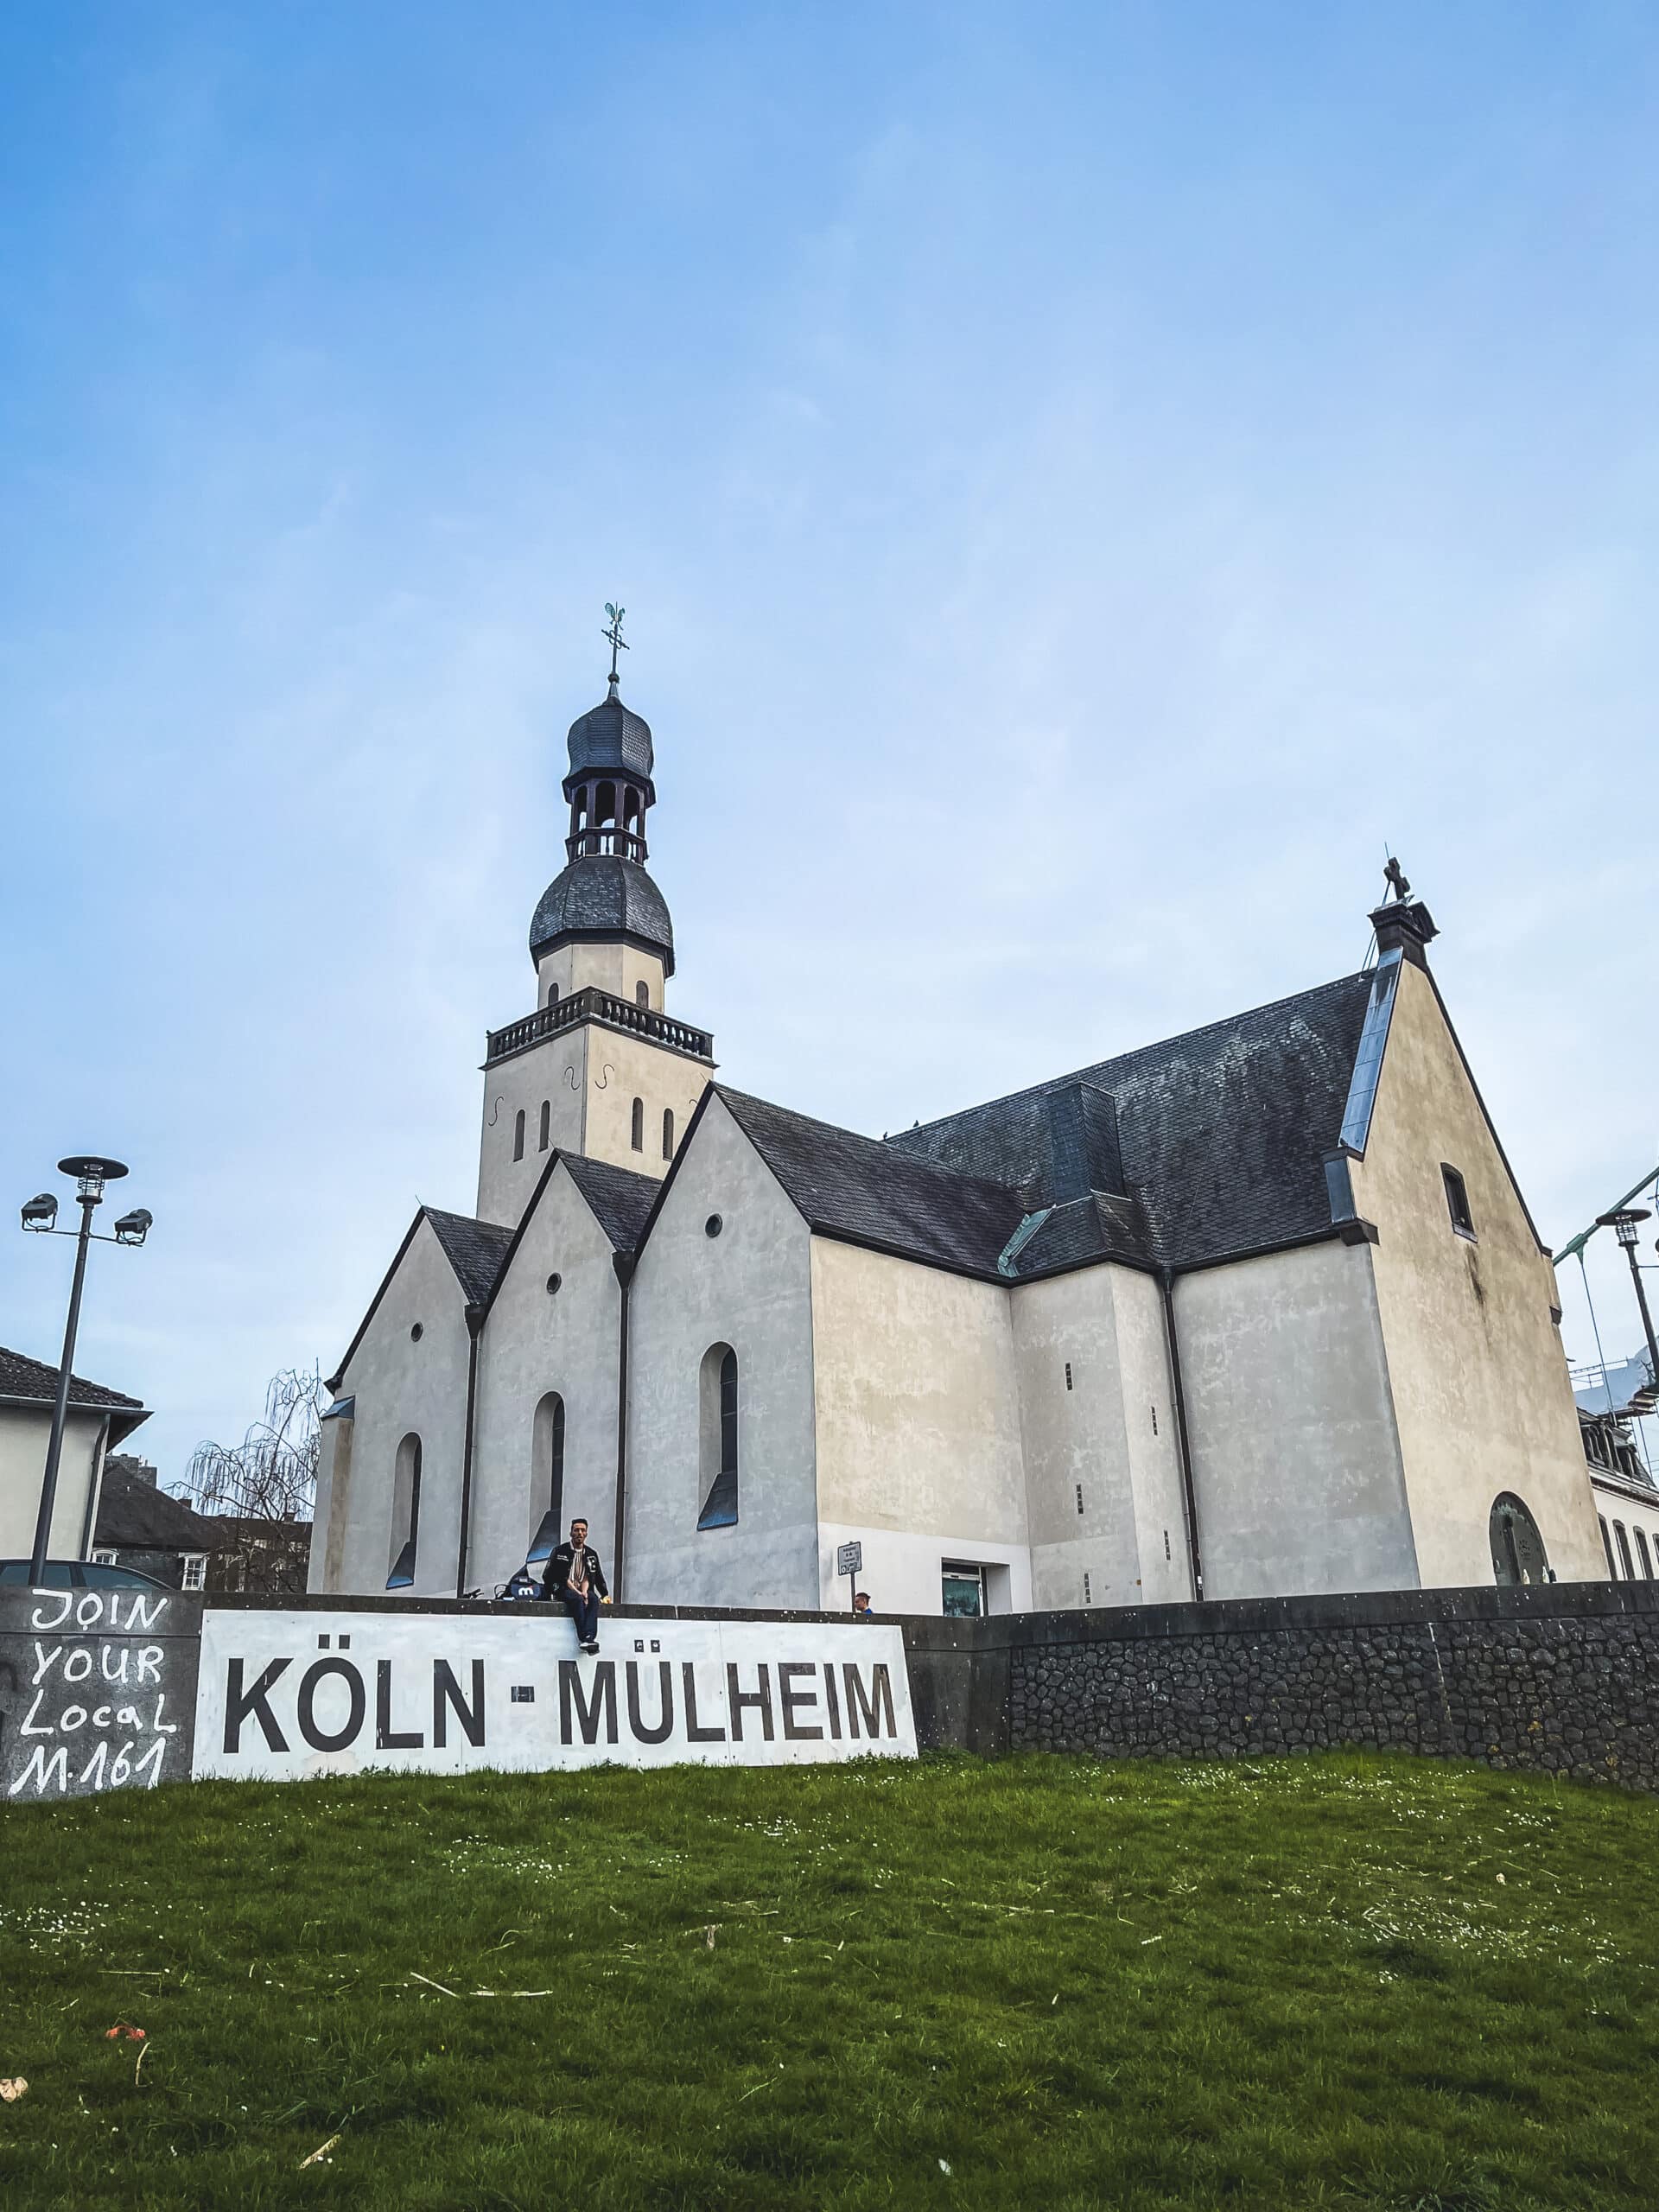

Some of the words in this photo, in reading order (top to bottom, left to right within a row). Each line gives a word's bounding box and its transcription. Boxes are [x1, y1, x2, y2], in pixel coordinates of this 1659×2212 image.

[32, 1588, 168, 1630] JOIN
[32, 1642, 164, 1684] YOUR
[223, 1634, 486, 1753] KÖLN
[557, 1639, 897, 1745] MÜLHEIM
